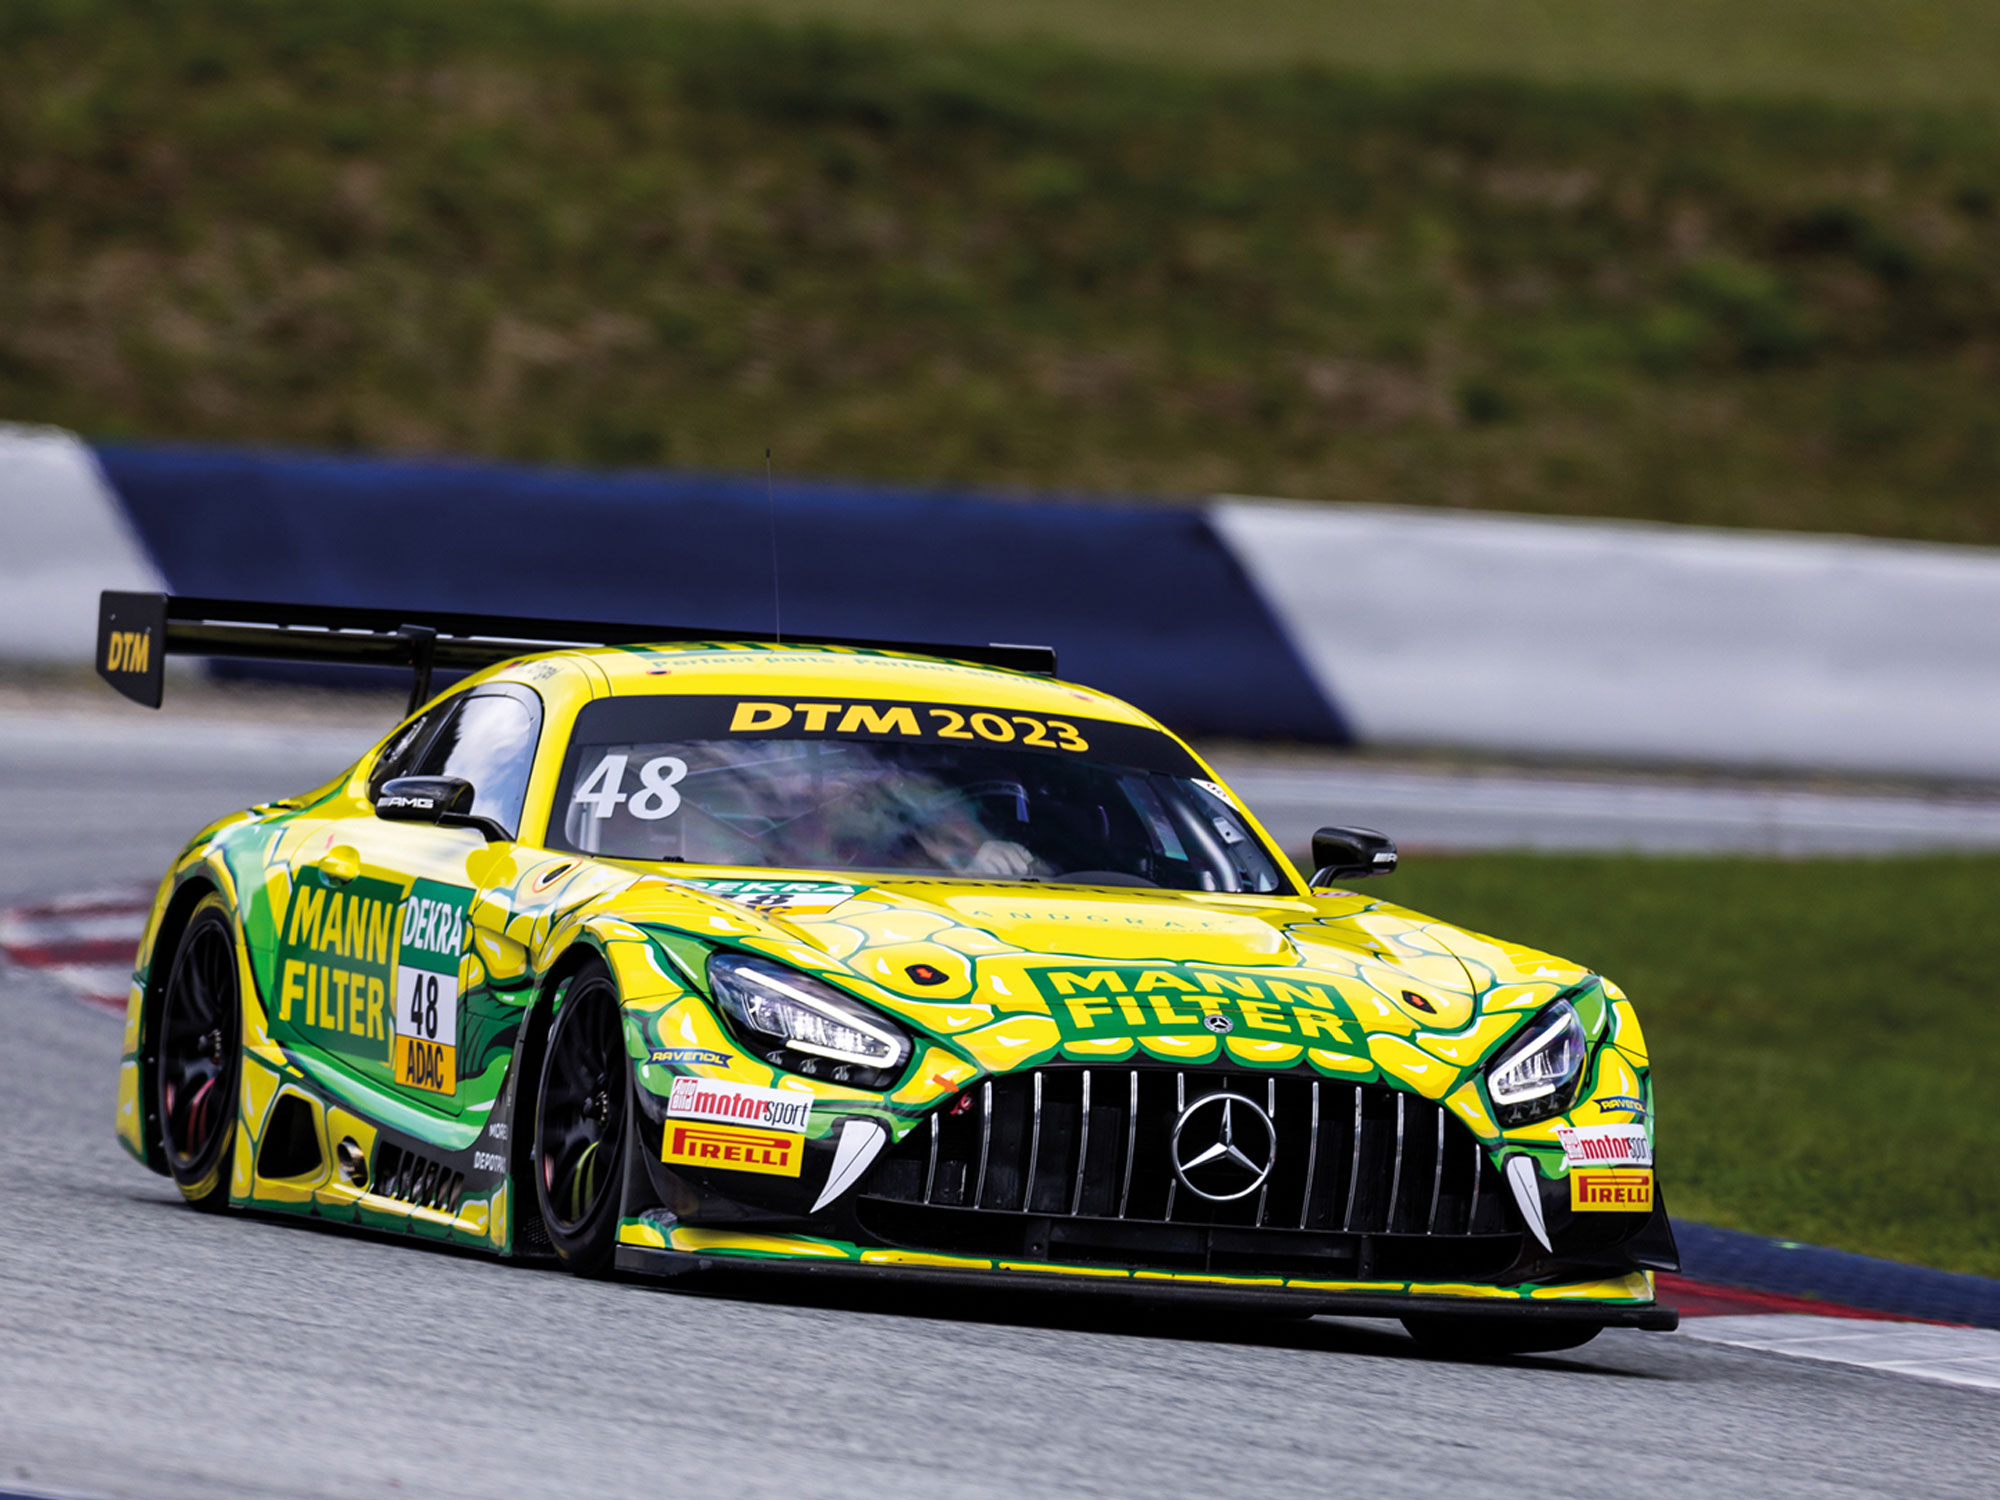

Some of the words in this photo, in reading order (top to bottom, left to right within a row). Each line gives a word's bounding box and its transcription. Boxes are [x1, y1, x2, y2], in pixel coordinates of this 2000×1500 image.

[107, 631, 149, 673] DTM
[729, 702, 922, 735] DTM
[929, 709, 1089, 752] 2023
[388, 796, 434, 809] AMG
[575, 754, 688, 820] 48
[288, 885, 393, 965] MANN
[402, 896, 463, 957] DEKRA
[279, 958, 385, 1041] FILTER
[411, 973, 439, 1040] 48
[1047, 971, 1335, 1010] MANN
[1063, 995, 1353, 1044] FILTER
[406, 1040, 444, 1090] ADAC
[652, 1050, 726, 1065] RAVENOL
[694, 1092, 809, 1127] motorsport
[671, 1127, 792, 1167] PIRELLI
[1578, 1175, 1650, 1204] PIRELLI
